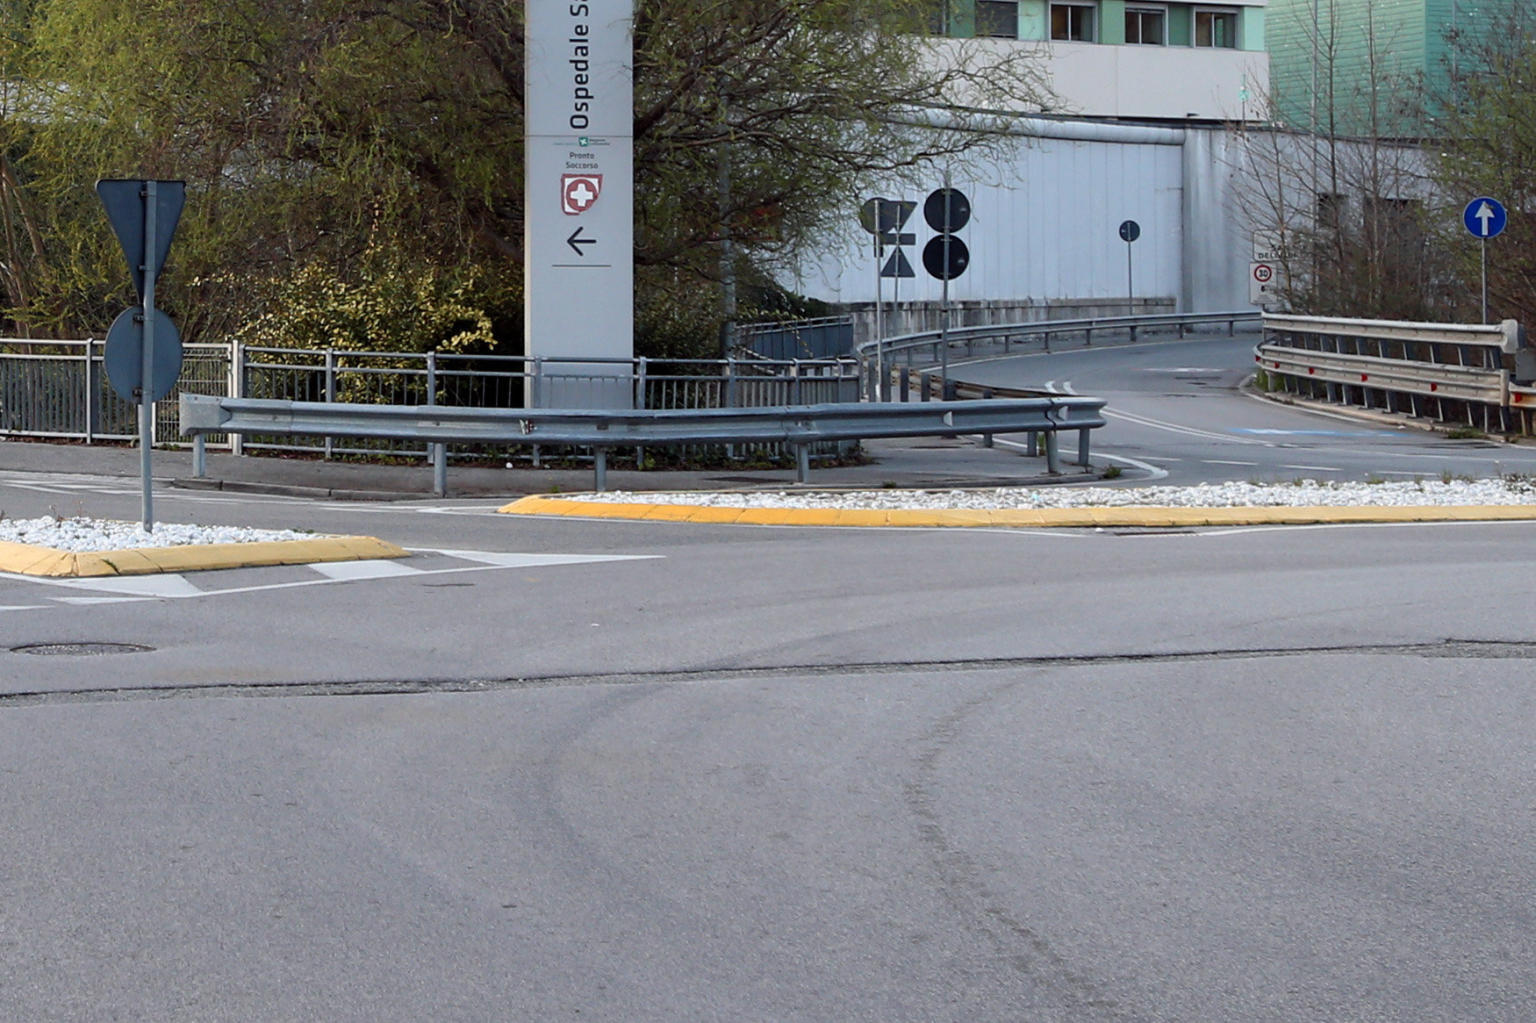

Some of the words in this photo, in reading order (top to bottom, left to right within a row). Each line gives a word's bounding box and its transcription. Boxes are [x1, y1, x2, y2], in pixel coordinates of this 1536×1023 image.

[568, 23, 595, 130] Ospedale
[569, 151, 595, 159] Pronto
[566, 161, 599, 169] Soccorso
[1259, 269, 1268, 278] 30
